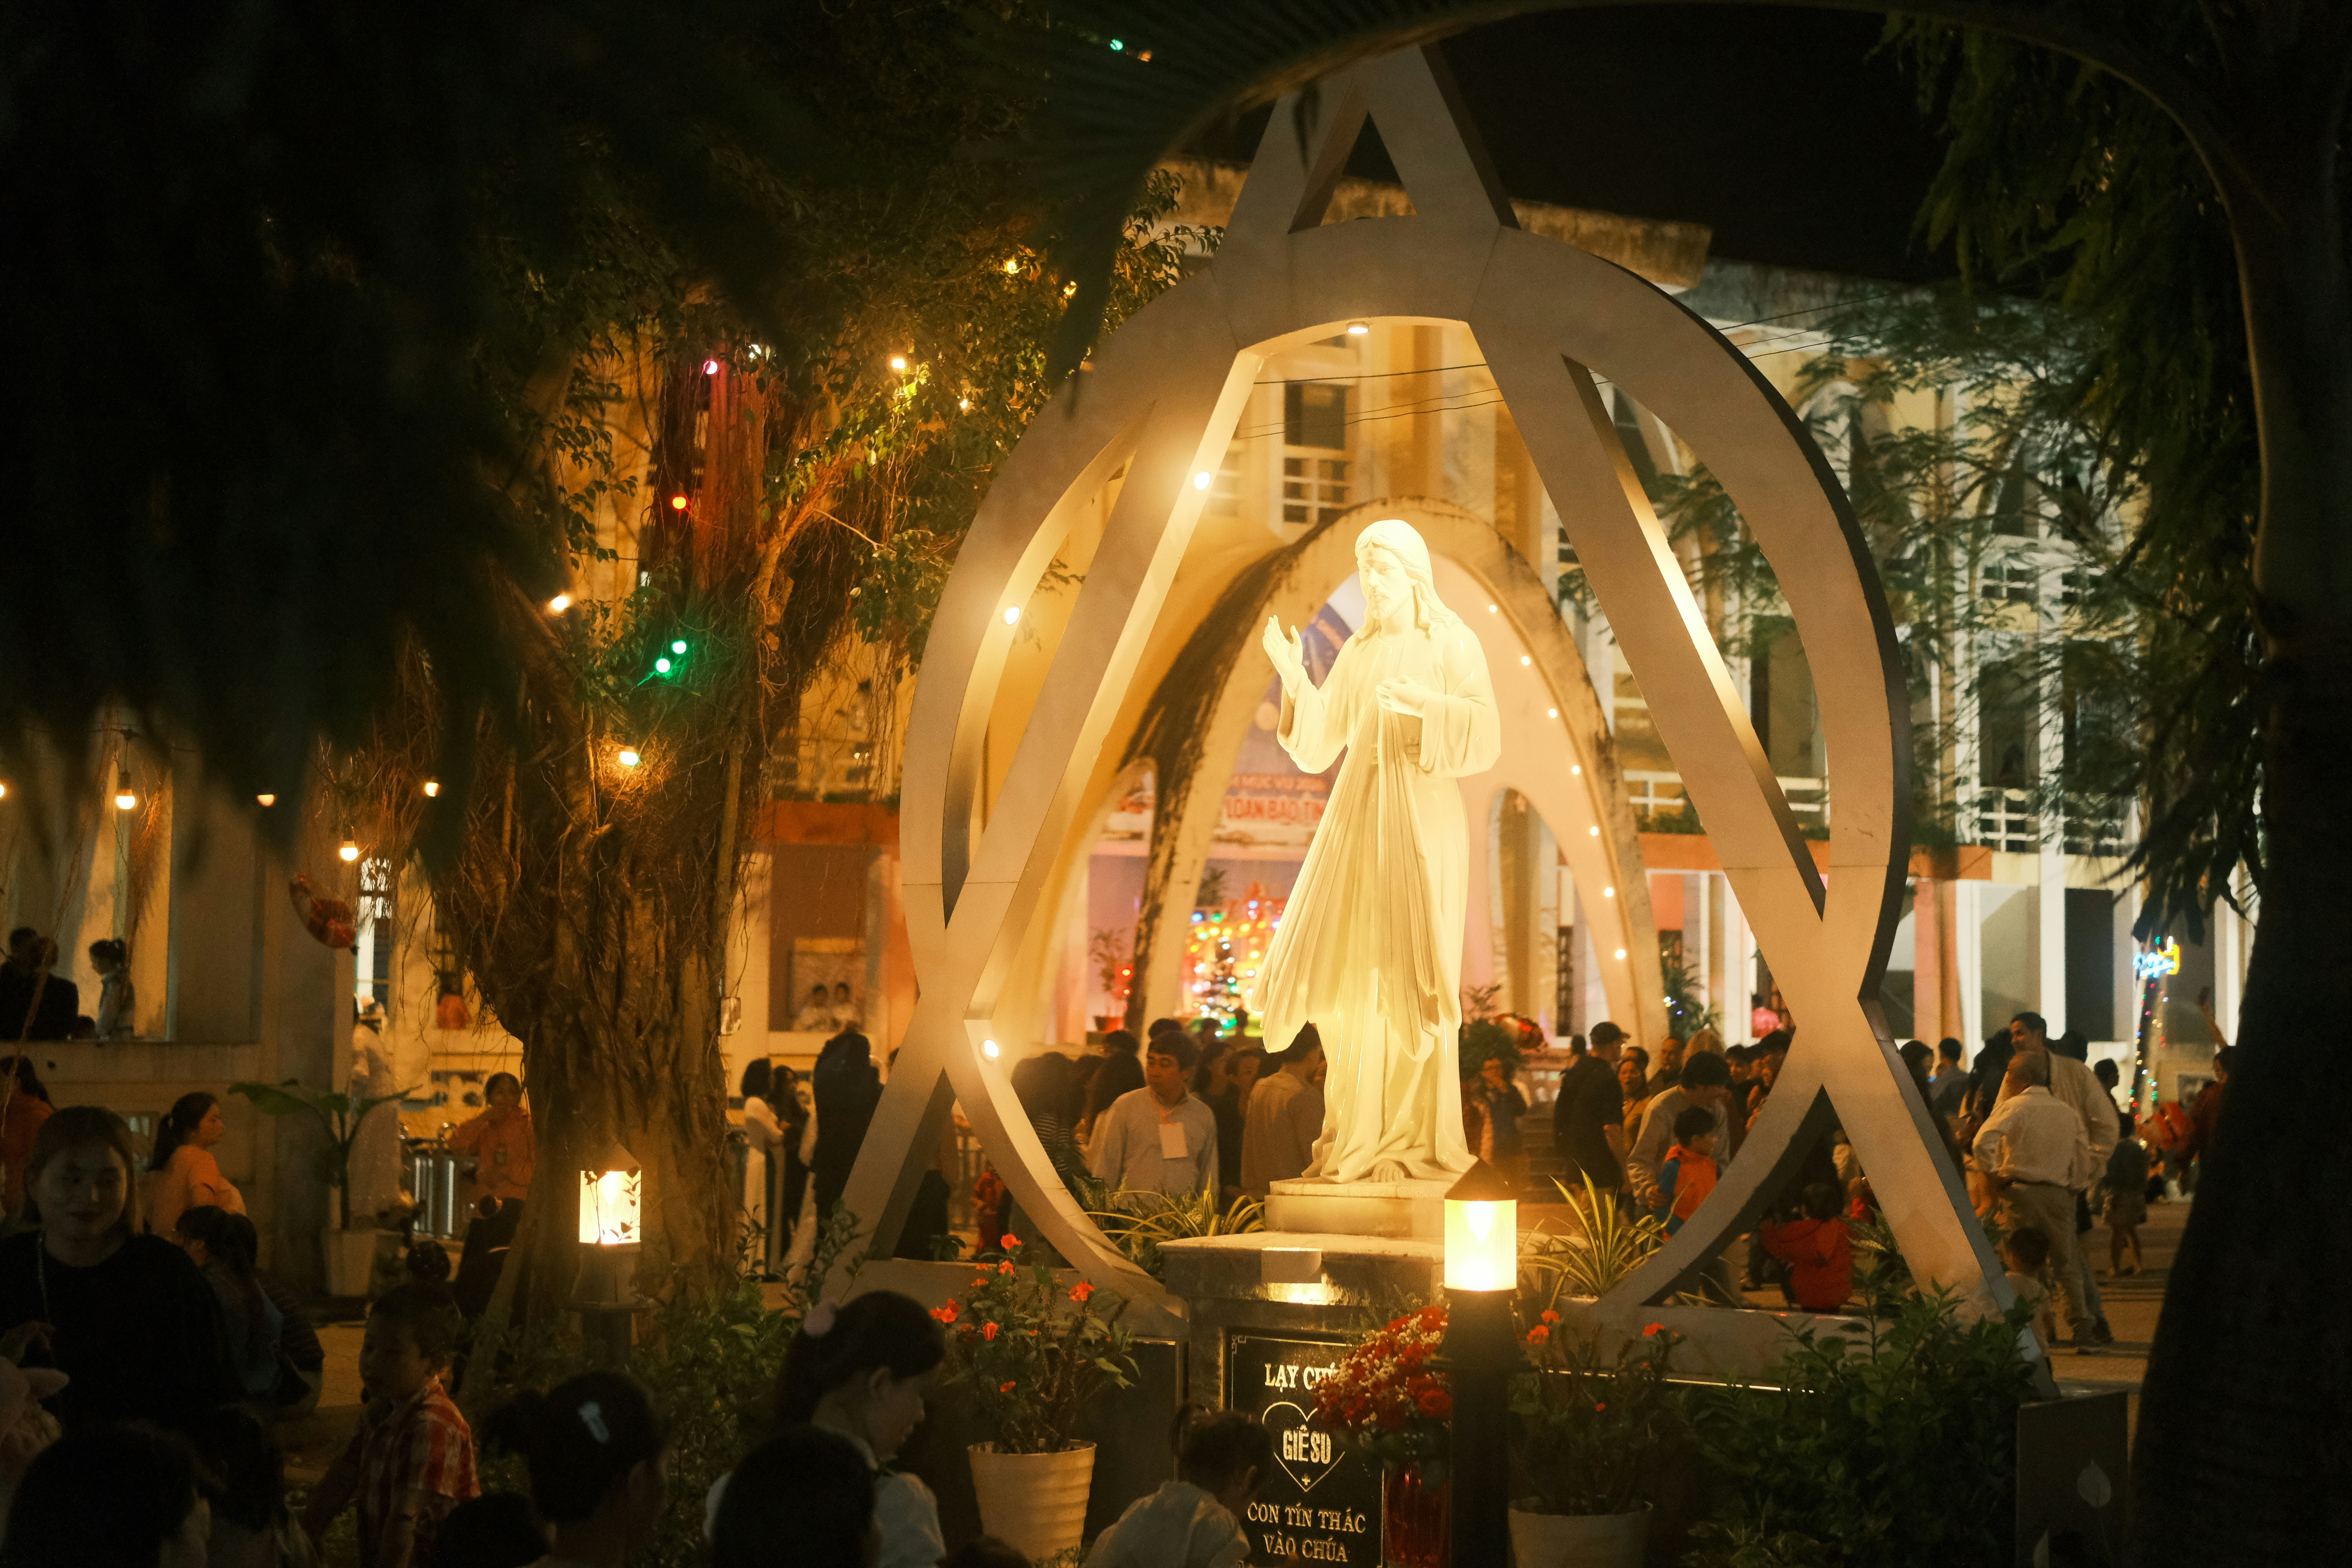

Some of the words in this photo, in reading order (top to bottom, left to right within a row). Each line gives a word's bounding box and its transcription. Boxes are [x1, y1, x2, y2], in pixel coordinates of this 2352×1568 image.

[1265, 1363, 1299, 1392] LẠY
[1248, 1501, 1280, 1524] CON
[1285, 1501, 1313, 1527] TÍN
[1318, 1507, 1366, 1533] THÁC
[1263, 1530, 1296, 1555] VÀO
[1302, 1536, 1348, 1562] CHÚA
